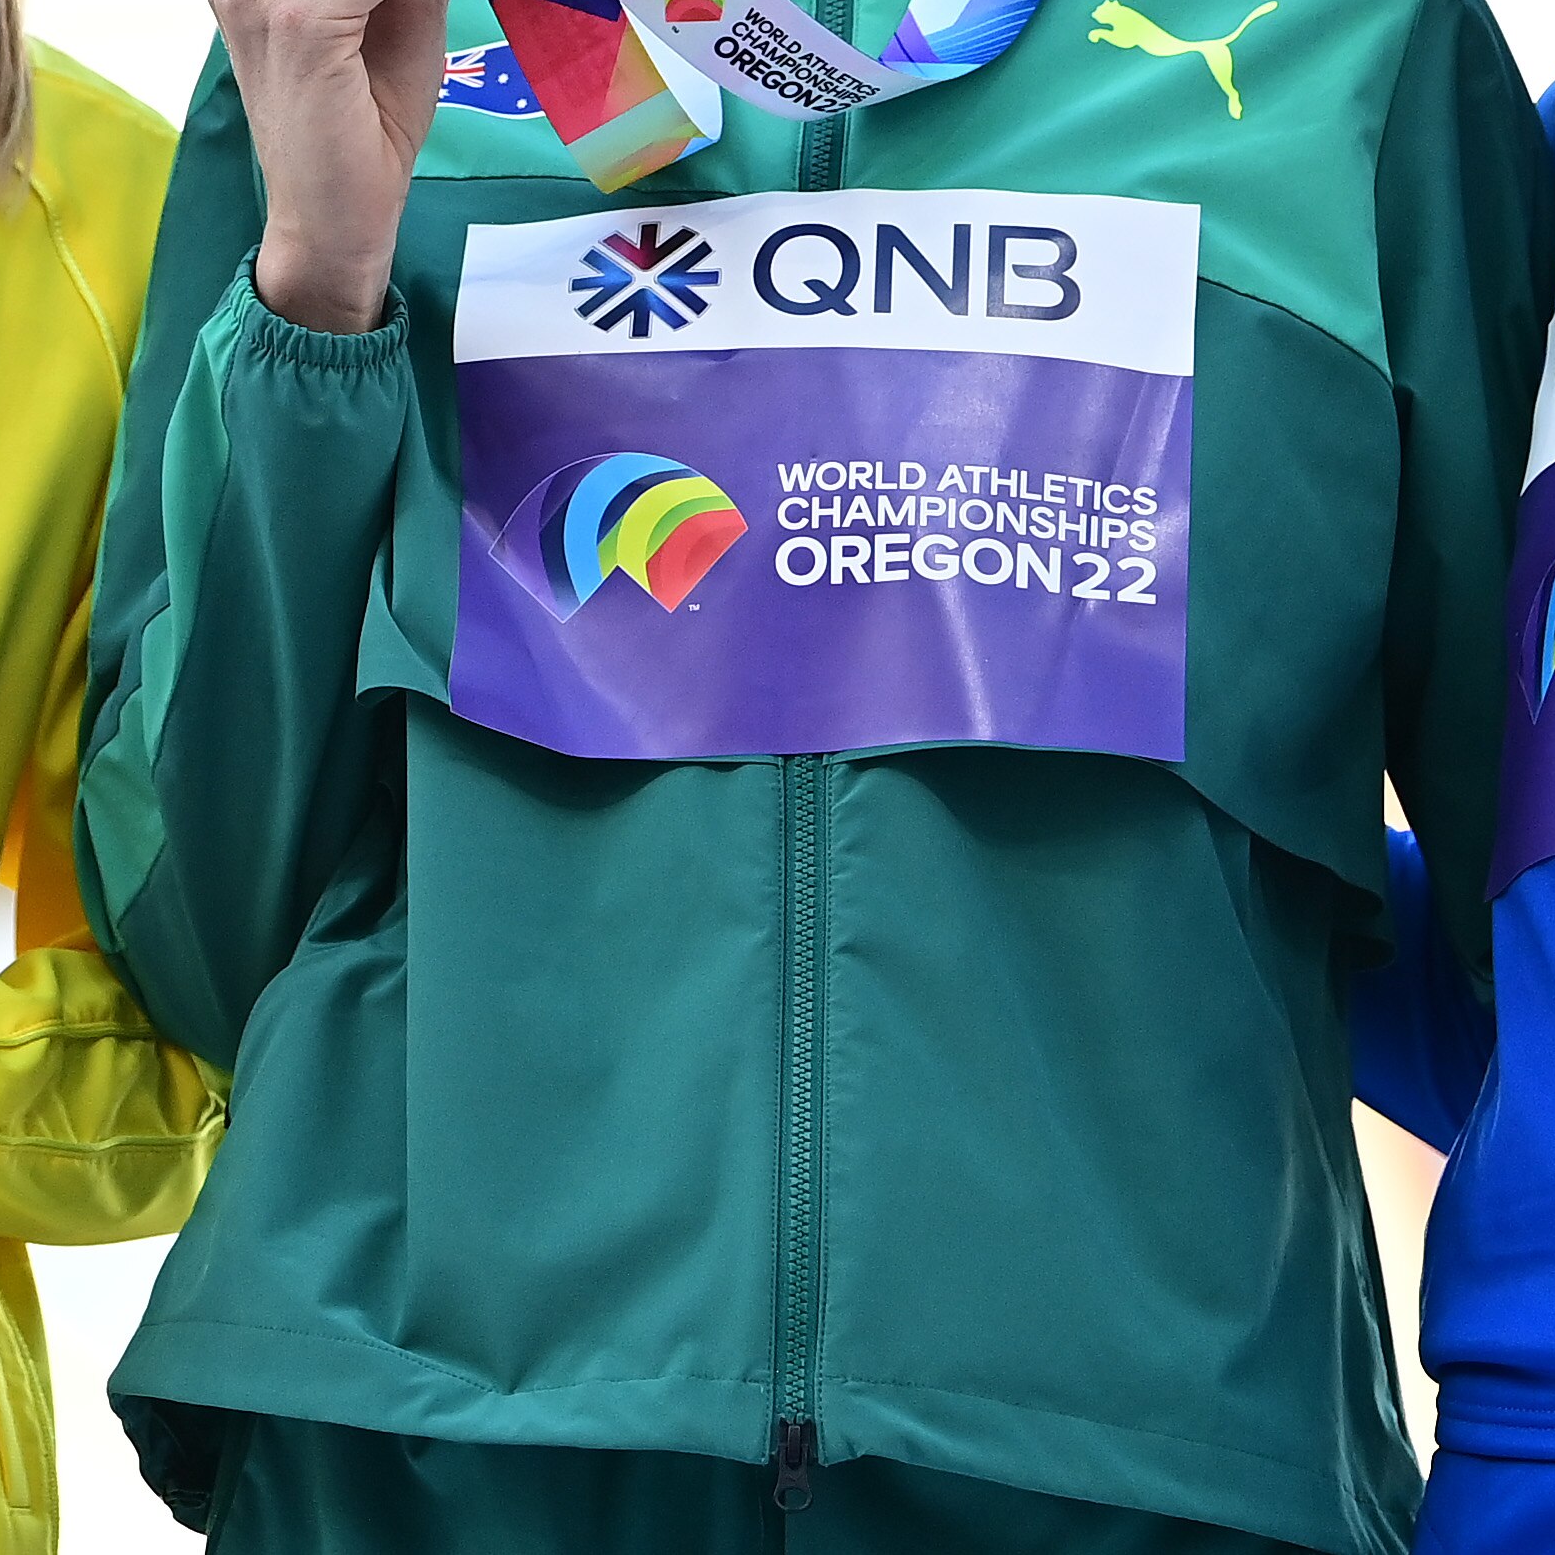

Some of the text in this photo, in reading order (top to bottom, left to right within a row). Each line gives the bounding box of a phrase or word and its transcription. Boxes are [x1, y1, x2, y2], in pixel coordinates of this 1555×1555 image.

[731, 21, 868, 105] CHAMPIONSHIPS
[744, 7, 881, 96] WORLD ATHLETICS
[753, 224, 1081, 320] QNB
[777, 461, 1158, 515] WORLD ATHLETICS
[777, 495, 1157, 551] CHAMPIONSHIPS
